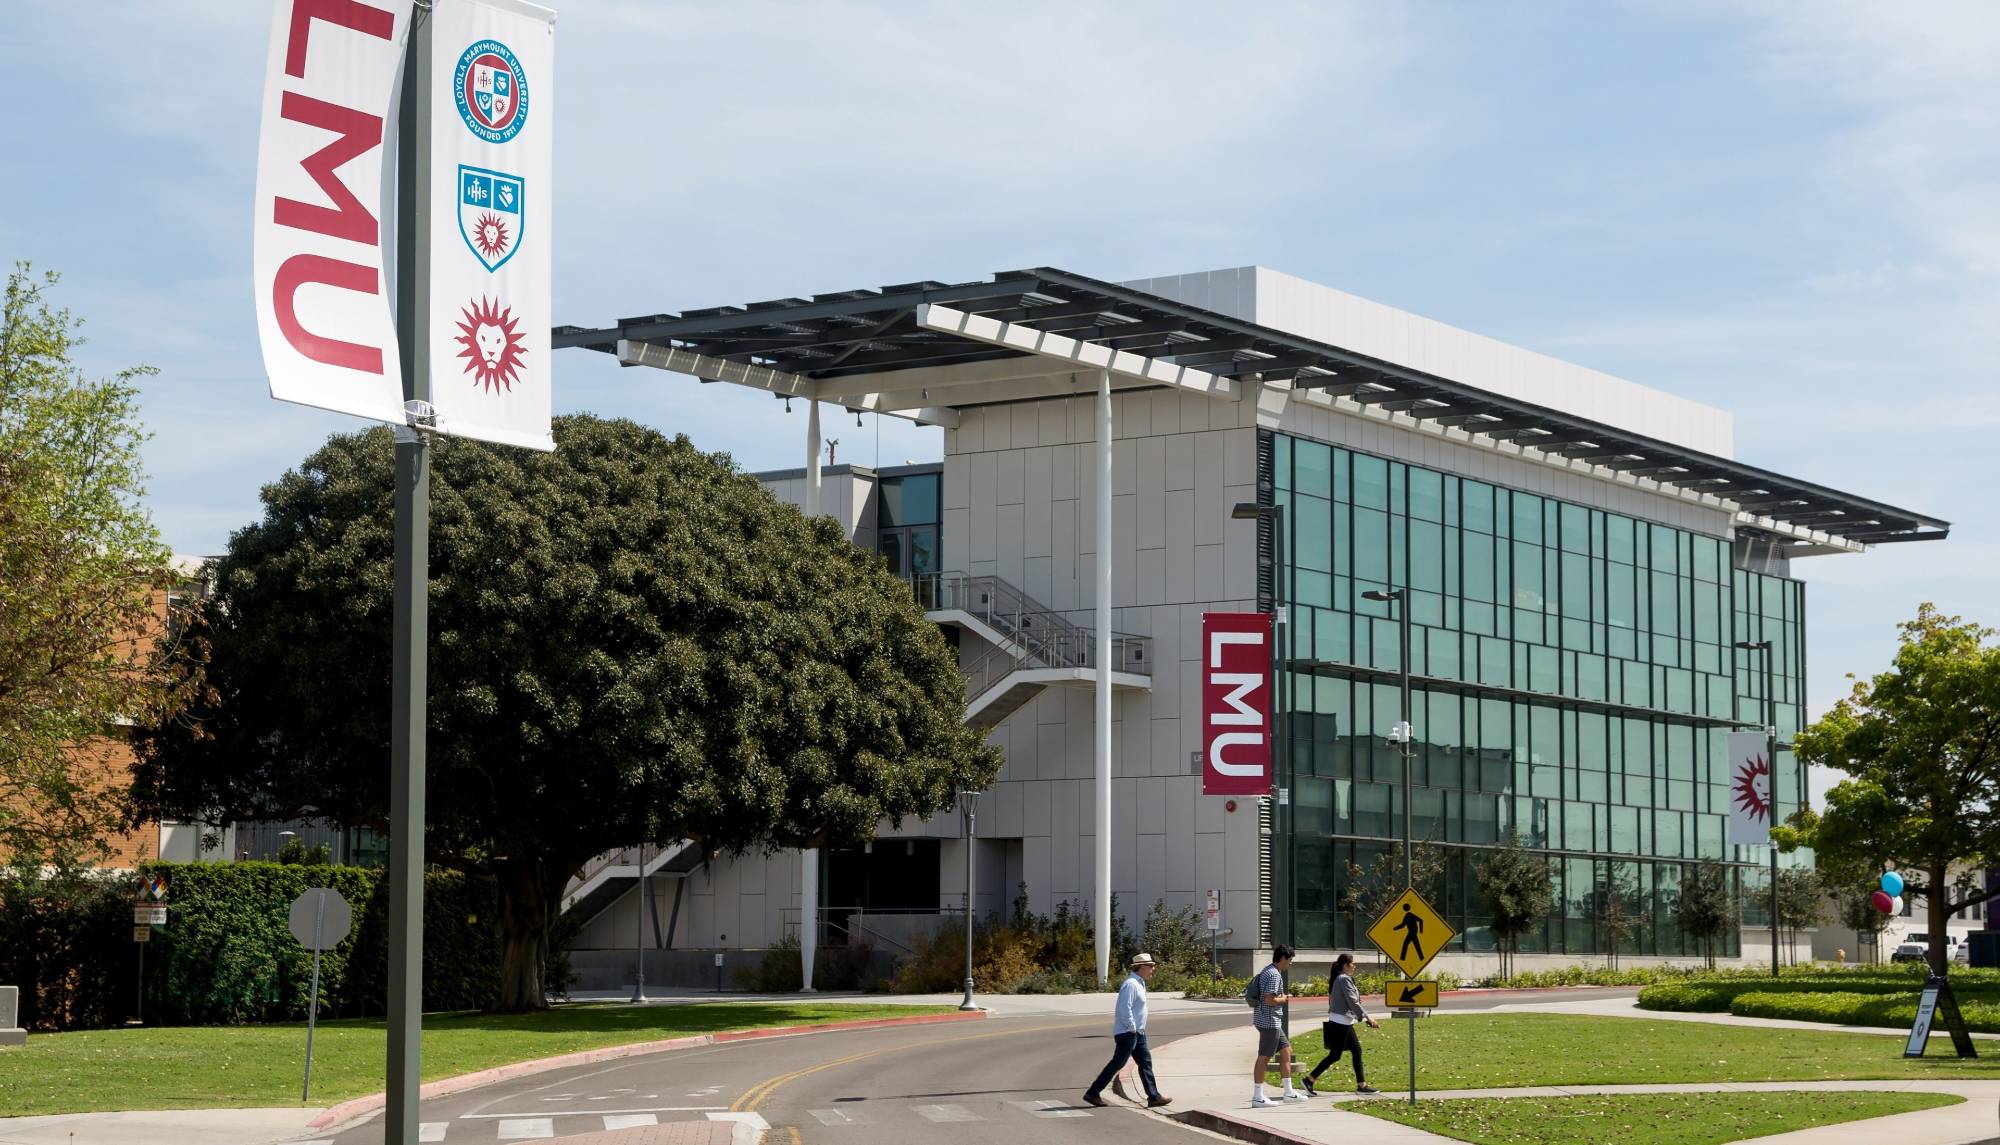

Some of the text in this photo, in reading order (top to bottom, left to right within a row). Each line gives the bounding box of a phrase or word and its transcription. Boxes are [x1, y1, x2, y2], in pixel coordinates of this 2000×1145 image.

[455, 42, 527, 120] LOYOLA MARYMOUNT UNIVERSITY
[465, 114, 516, 141] FOUNDED 1911
[273, 0, 395, 375] LMU
[1210, 632, 1264, 777] LMU
